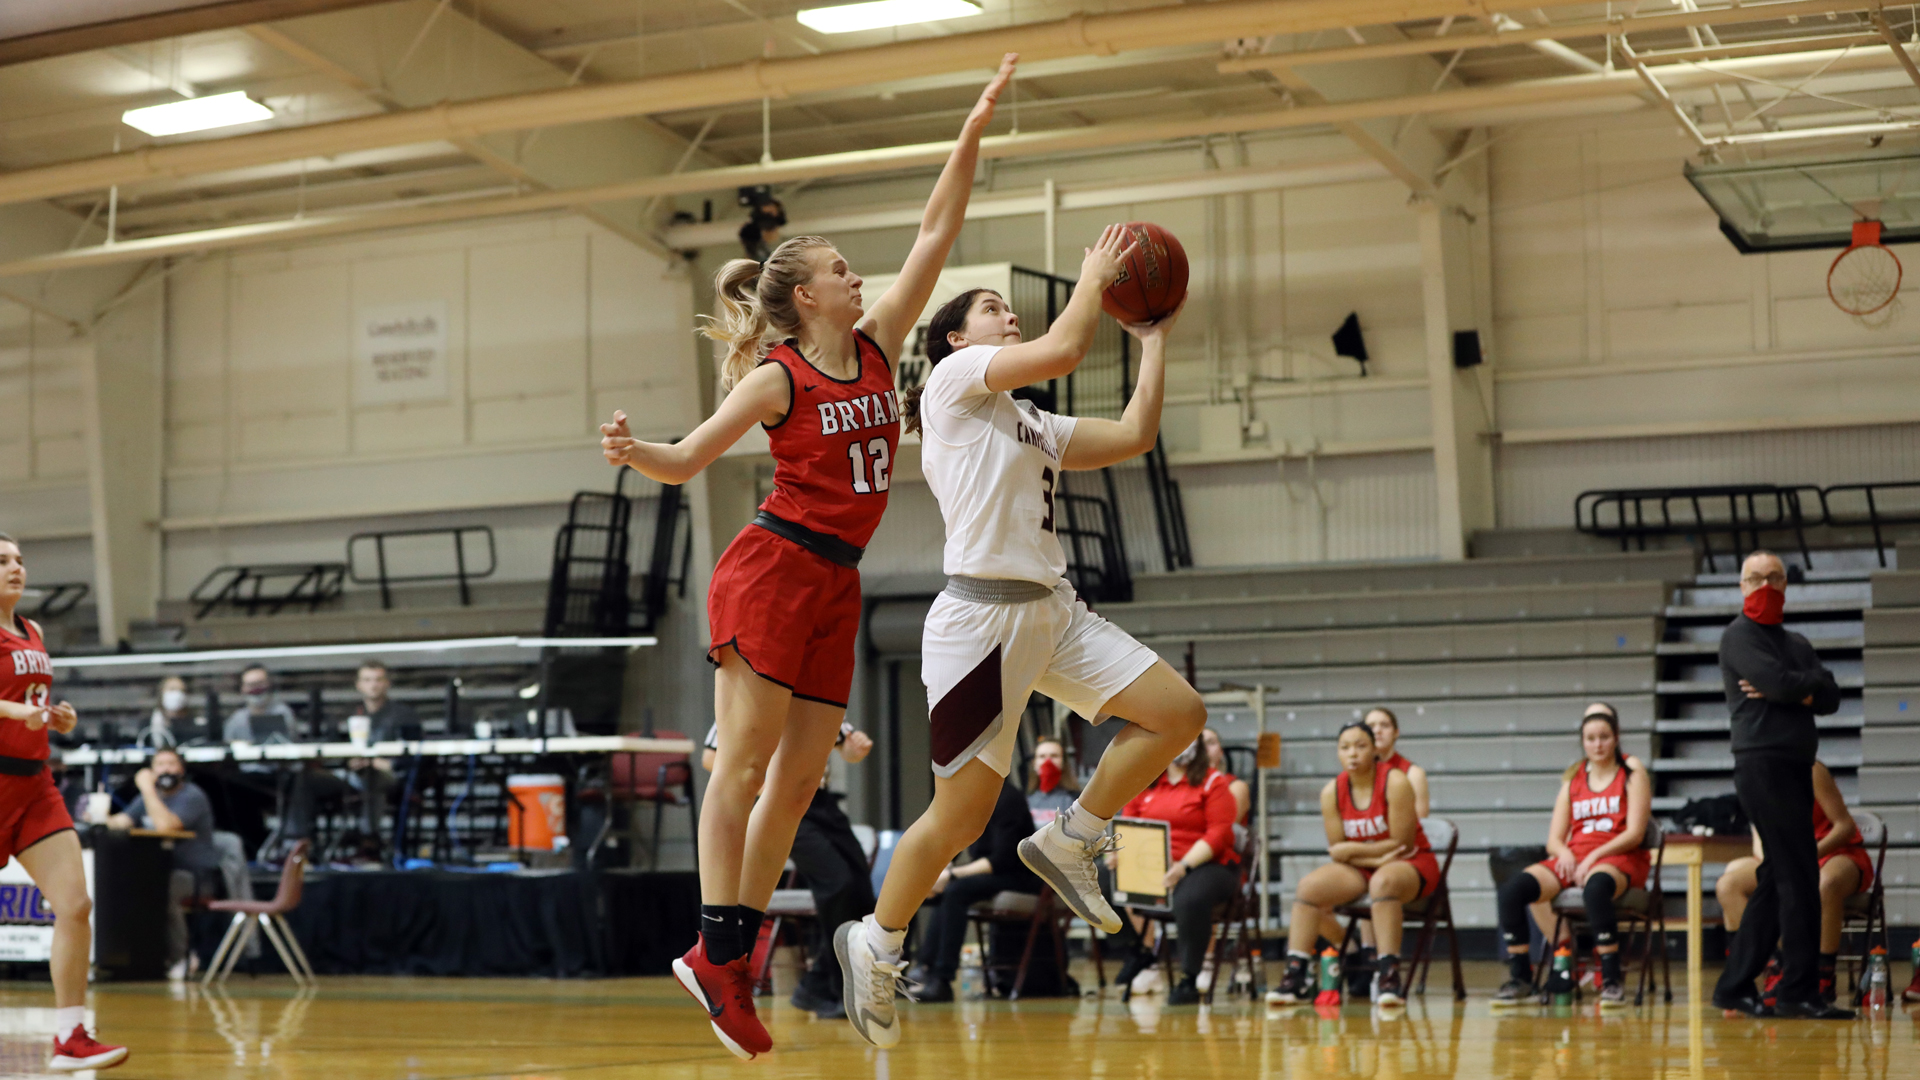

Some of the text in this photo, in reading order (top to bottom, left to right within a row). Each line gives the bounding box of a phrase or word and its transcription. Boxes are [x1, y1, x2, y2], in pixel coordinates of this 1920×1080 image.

[817, 389, 899, 436] BRYAN
[847, 436, 889, 495] 12
[1041, 465, 1054, 534] 3
[11, 649, 54, 676] BRYA
[1572, 795, 1620, 821] BRYAN
